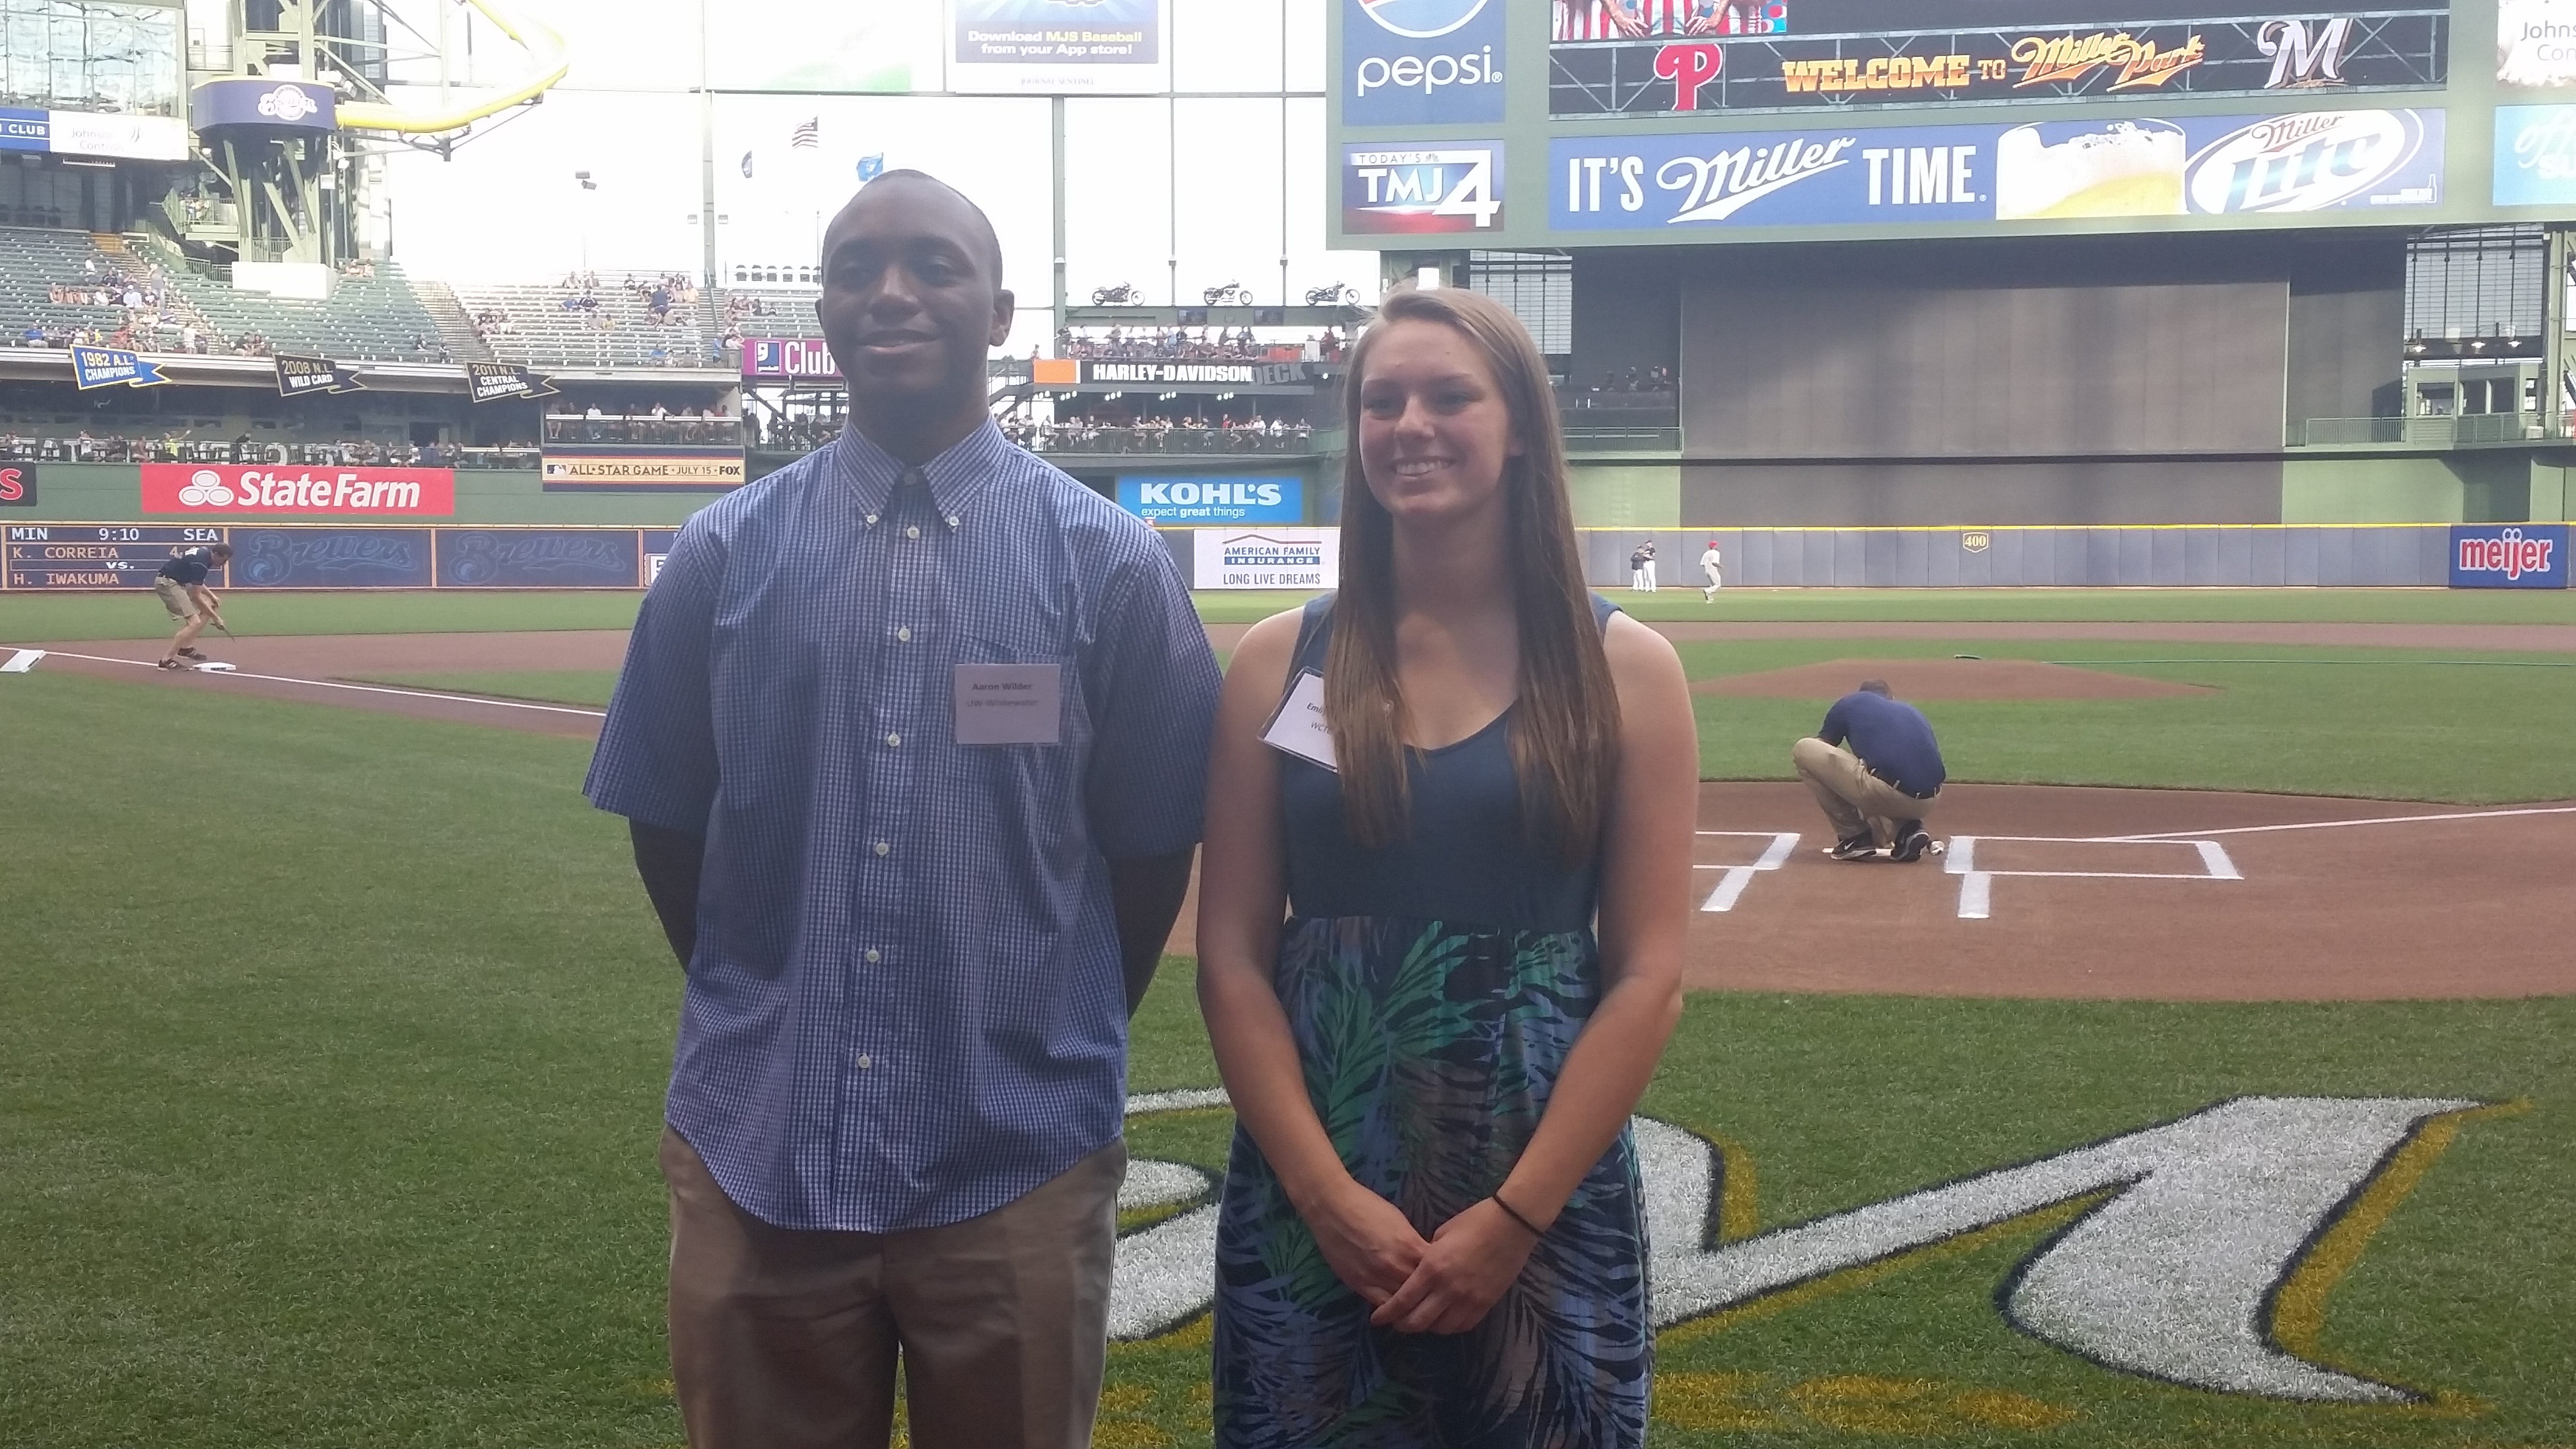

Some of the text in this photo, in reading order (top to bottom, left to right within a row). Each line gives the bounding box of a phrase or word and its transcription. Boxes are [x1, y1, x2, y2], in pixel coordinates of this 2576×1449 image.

[968, 31, 1142, 42] Download MJS Baseball
[981, 43, 1132, 56] from your App store!
[1782, 32, 2206, 93] WELCOME TO Miller Park
[8, 124, 46, 135] CLUB
[2251, 114, 2348, 154] Miller
[1359, 153, 1421, 164] TODAY'S
[2223, 132, 2382, 213] Lite
[1568, 156, 1644, 212] IT'S
[1657, 138, 1857, 224] Miller
[81, 352, 111, 367] 1982
[785, 341, 835, 375] Club
[85, 366, 136, 381] CHAMPIONS
[281, 360, 334, 374] 2008 N.L.
[472, 364, 498, 376] 2011
[1093, 364, 1253, 382] HARLEY-DAVIDSON
[289, 374, 333, 388] WILD CARD
[480, 375, 519, 386] CENTRAL
[477, 382, 528, 397] CHAMPIONS
[634, 465, 669, 476] GAME
[677, 467, 698, 475] JULY
[702, 467, 711, 475] 15
[719, 466, 741, 476] FOX
[1141, 483, 1282, 506] KOHL'S
[1141, 507, 1245, 518] expect great things
[12, 527, 218, 541] MIN 9:10 SEA
[1965, 536, 1986, 547] 400
[13, 547, 32, 559] K.
[45, 547, 119, 559] CORREIA
[242, 530, 417, 586] Brewers
[448, 531, 625, 584] Brewers
[1224, 547, 1320, 556] AMERICAN FAMILY
[2460, 529, 2552, 580] meijer
[105, 561, 135, 569] vs.
[14, 573, 119, 585] H. IWAKUMA
[1224, 573, 1320, 585] LONG LIVE DREAMS
